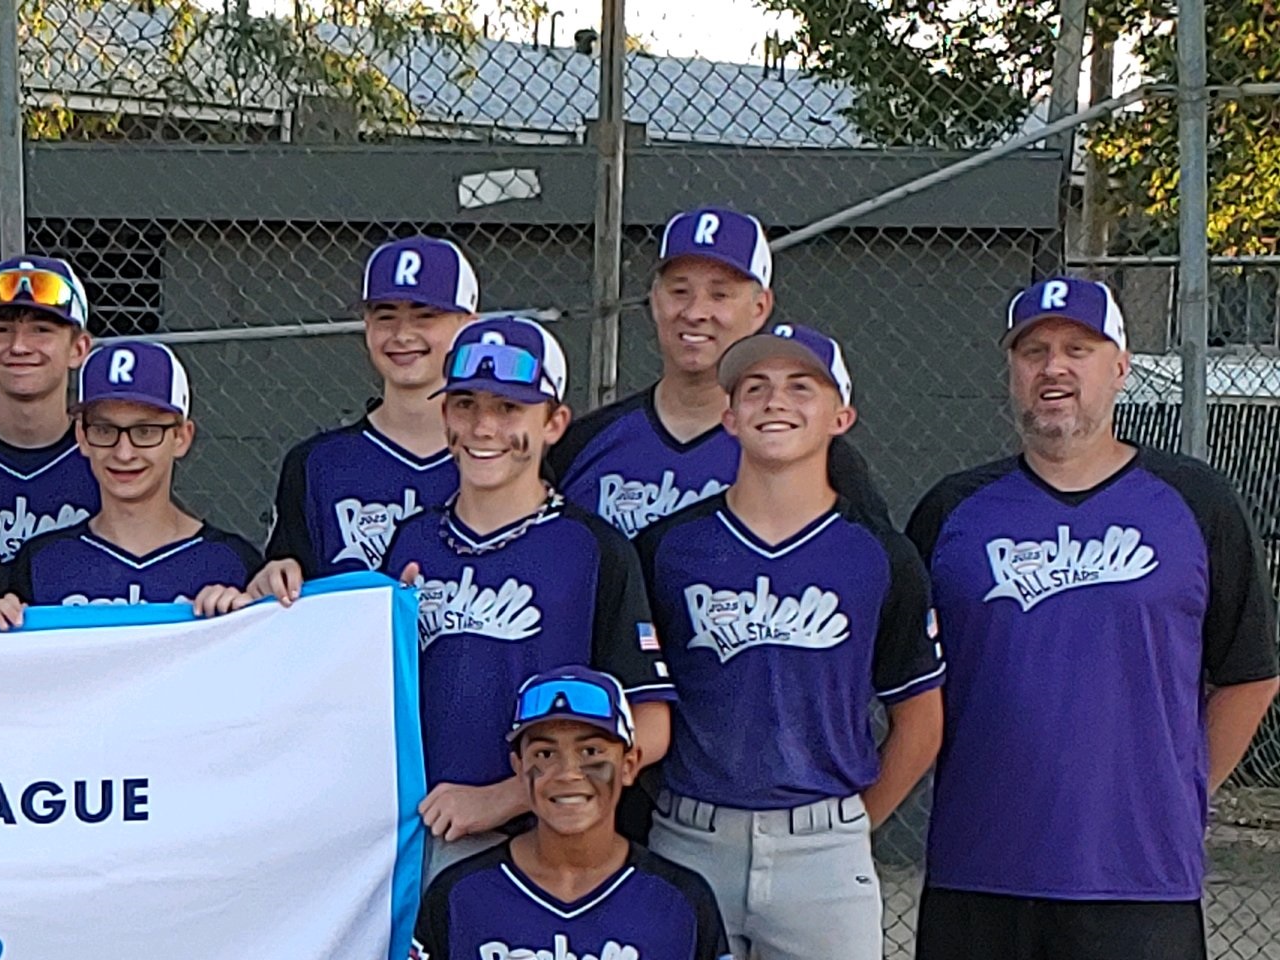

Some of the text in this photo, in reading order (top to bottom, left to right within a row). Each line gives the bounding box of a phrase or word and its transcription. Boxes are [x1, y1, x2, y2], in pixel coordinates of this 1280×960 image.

[694, 213, 720, 244] R
[395, 250, 422, 286] R
[1041, 280, 1069, 310] R
[109, 349, 136, 384] R
[985, 525, 1159, 588] Rochelle
[1013, 569, 1100, 603] ALL STARS
[684, 575, 851, 644] Rochelle
[714, 622, 791, 656] ALL STARS
